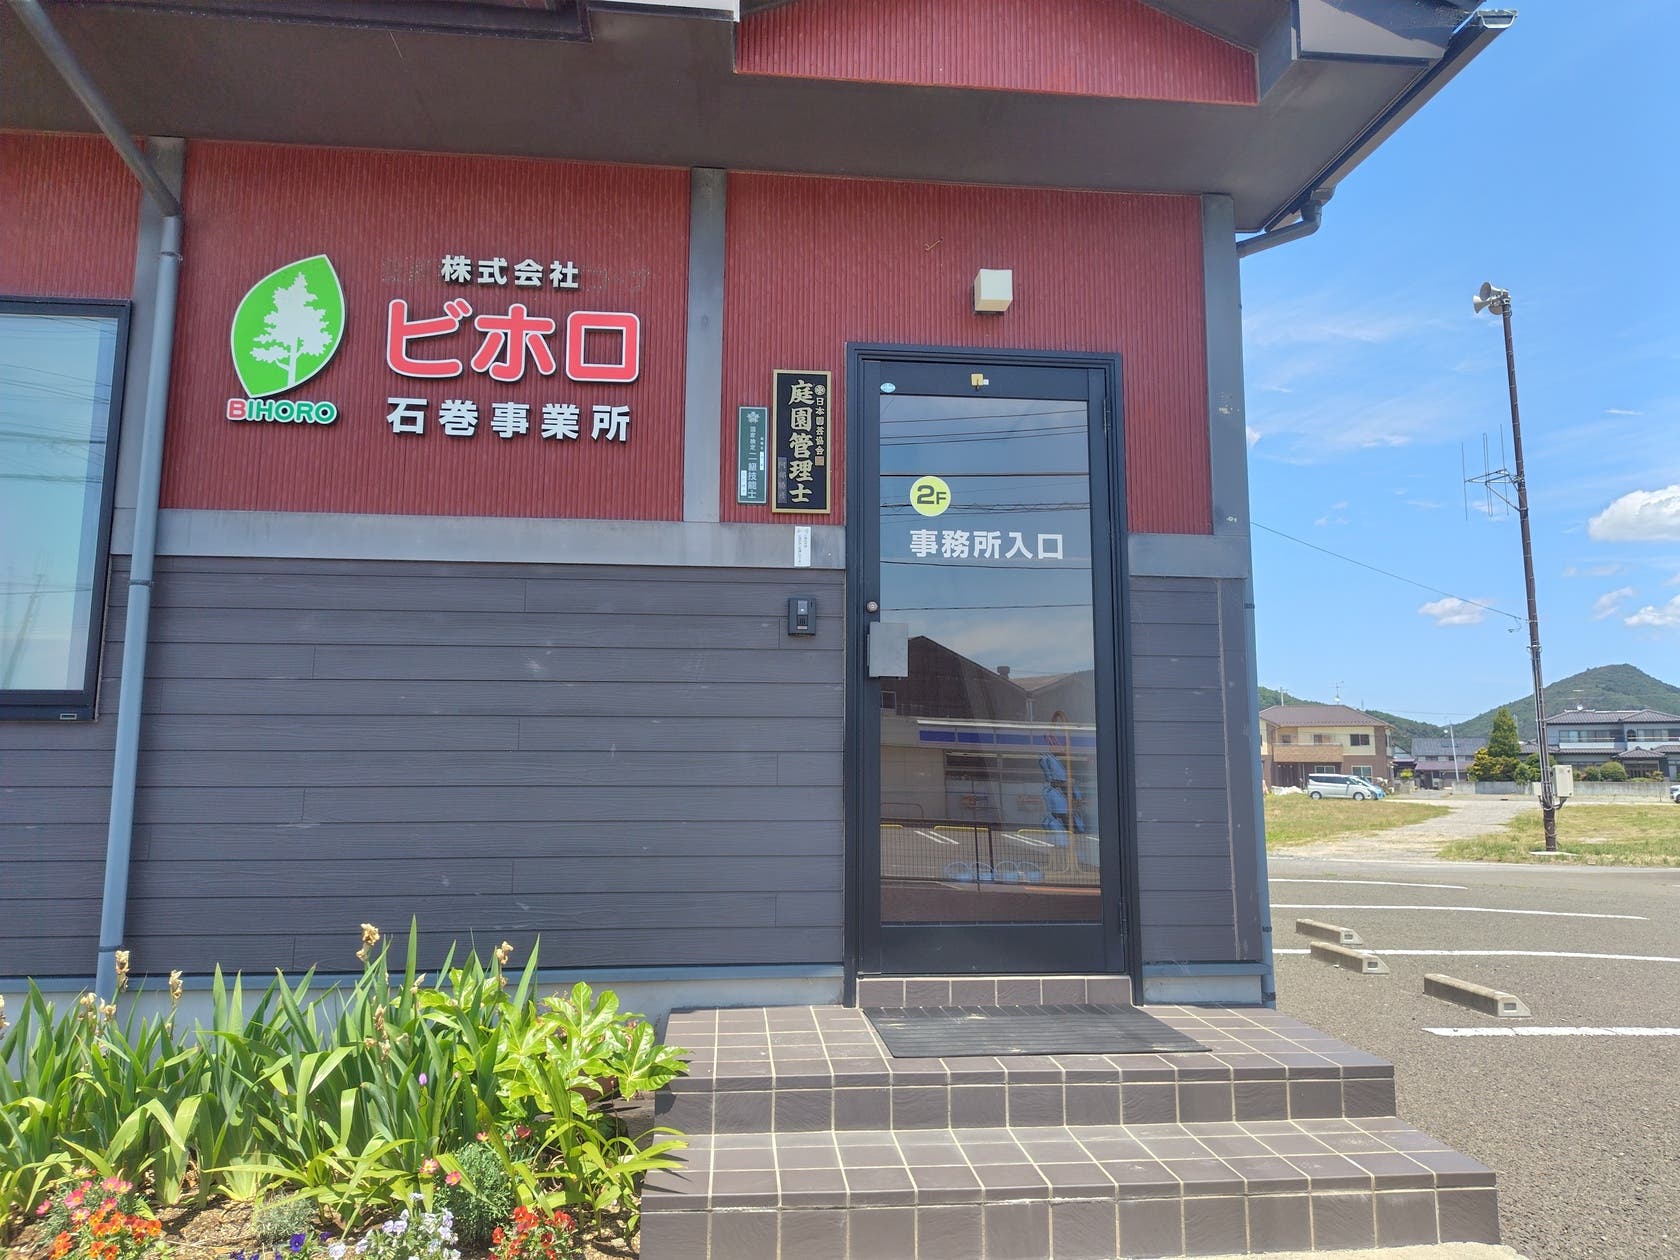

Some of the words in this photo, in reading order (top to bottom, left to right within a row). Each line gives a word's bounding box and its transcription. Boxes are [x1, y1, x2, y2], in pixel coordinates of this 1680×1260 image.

[441, 254, 579, 288] 株式会社
[387, 298, 640, 382] ビホロ
[227, 398, 337, 424] BIHORO
[386, 396, 631, 441] 石巻事業所
[788, 379, 815, 503] 庭園管理士
[916, 484, 948, 506] 2F
[909, 528, 1064, 560] 事務所入口
